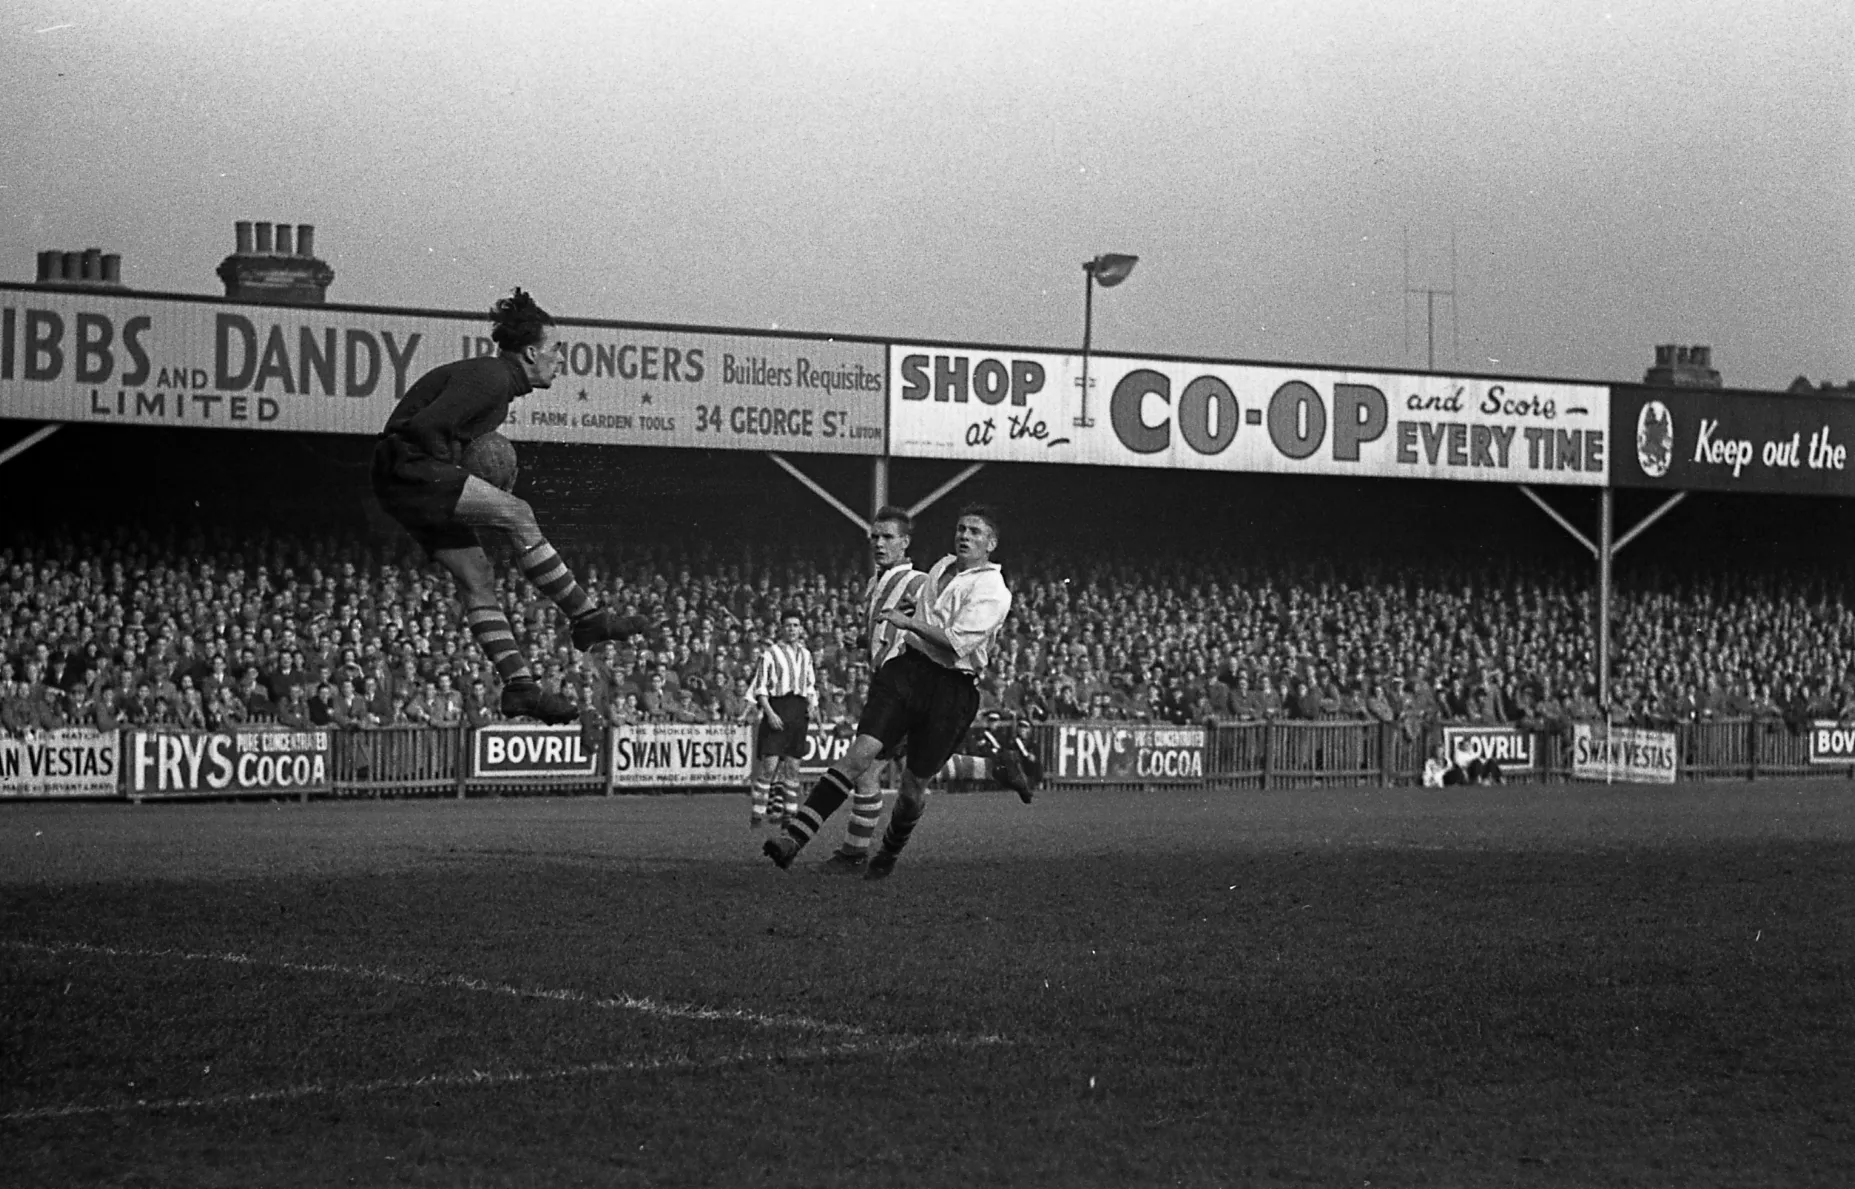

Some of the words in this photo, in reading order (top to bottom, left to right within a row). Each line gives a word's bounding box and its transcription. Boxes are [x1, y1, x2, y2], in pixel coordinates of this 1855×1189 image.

[157, 368, 208, 390] AND
[215, 313, 422, 400] DANDY
[462, 335, 705, 383] IRONGERS
[723, 353, 792, 388] Builders
[797, 357, 882, 396] Requisites
[901, 354, 1046, 407] SHOP
[91, 389, 281, 422] LIMITED
[1110, 368, 1388, 462] CO-OP
[1407, 385, 1464, 413] and
[1480, 385, 1557, 420] Score
[531, 411, 568, 427] FARM
[582, 412, 632, 429] GARDEN
[640, 415, 675, 431] TOOLS
[695, 404, 723, 433] 34
[730, 406, 813, 437] GEORGE
[966, 417, 997, 447] at
[1008, 407, 1049, 440] the
[1397, 420, 1516, 469] EVERY
[1524, 426, 1604, 473] TIME
[1694, 418, 1754, 478] Keep
[1762, 431, 1800, 468] out
[1808, 425, 1847, 470] the
[487, 735, 588, 764] BOVRIL
[617, 737, 672, 771] SWAN
[677, 738, 748, 769] VESTAS
[1818, 729, 1855, 754] BOV
[27, 745, 113, 777] VESTAS
[238, 752, 326, 787] COCOA
[1137, 748, 1202, 777] COCOA
